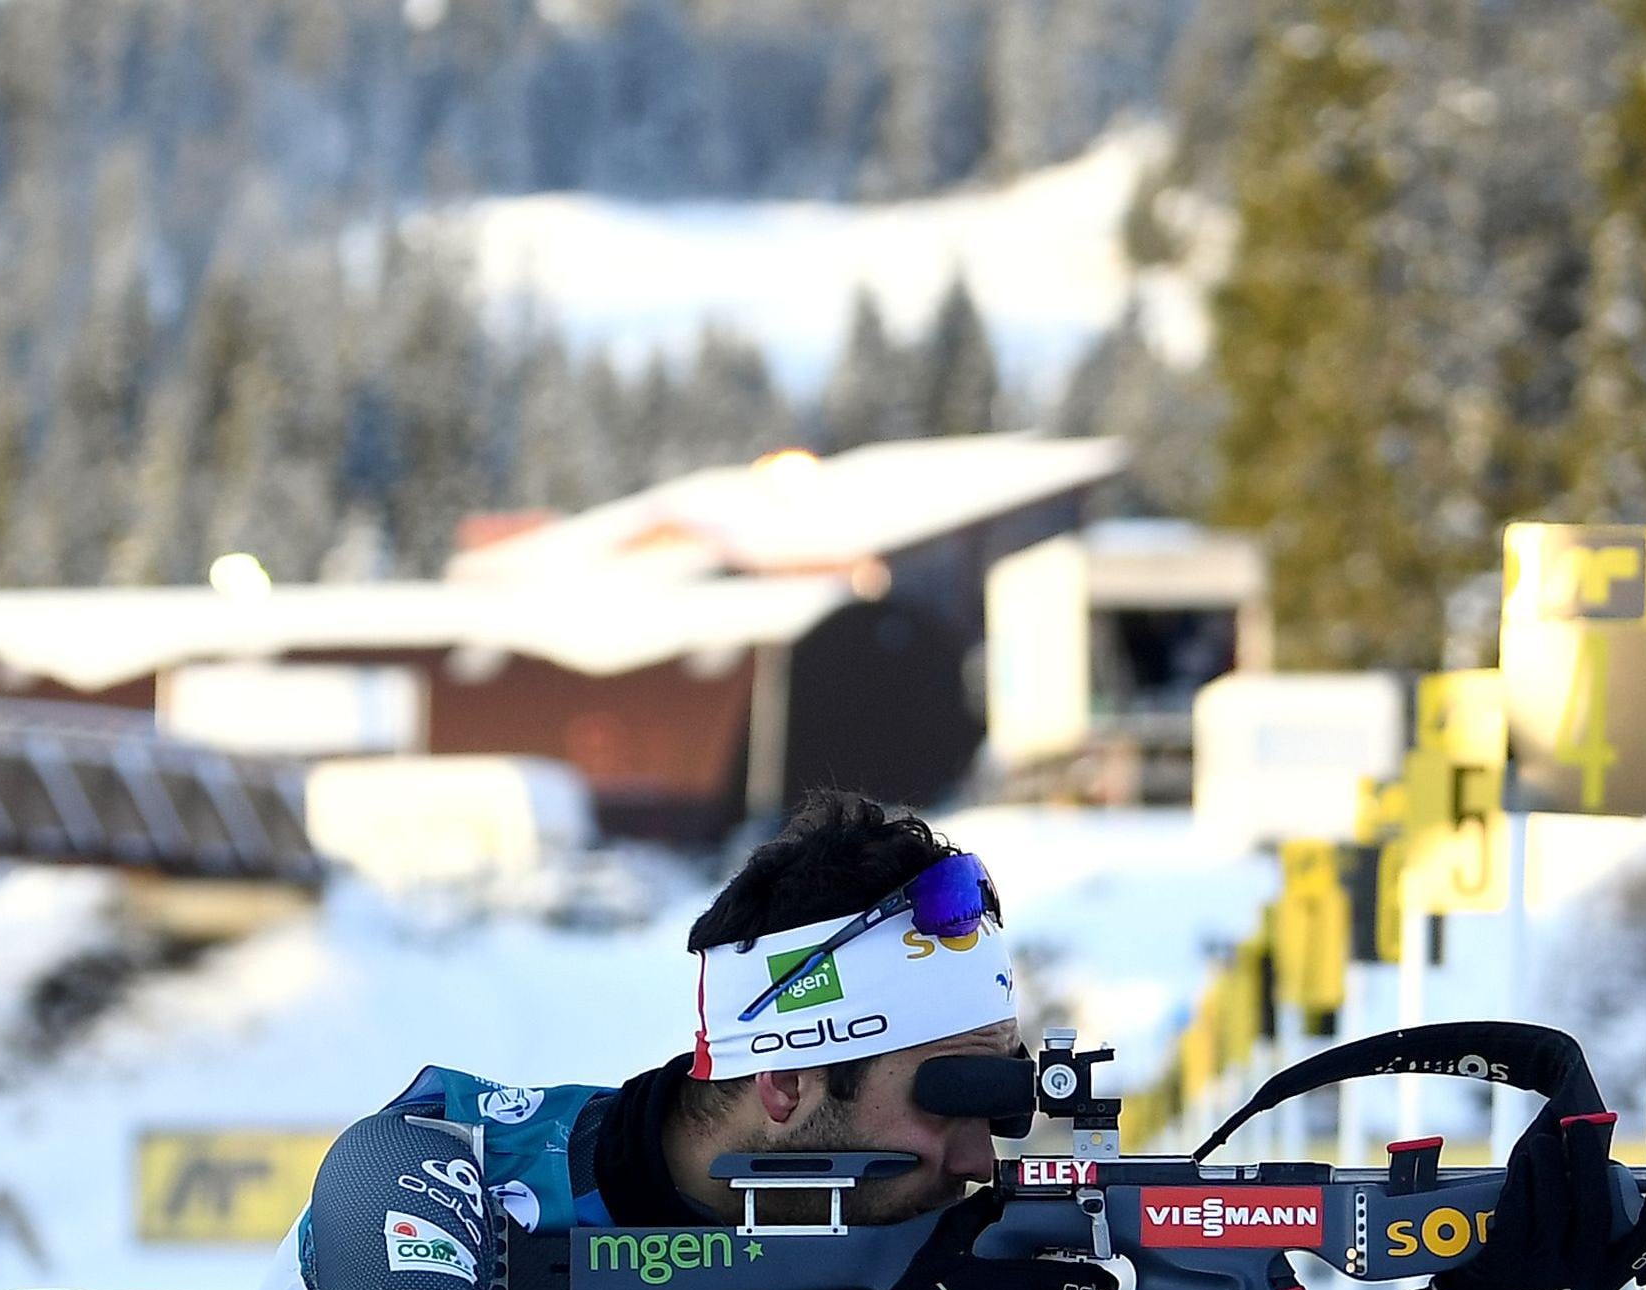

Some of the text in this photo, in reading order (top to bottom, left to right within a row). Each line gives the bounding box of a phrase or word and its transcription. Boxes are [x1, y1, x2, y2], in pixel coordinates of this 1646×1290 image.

[1556, 630, 1618, 808] 4
[1449, 764, 1491, 898] 5
[750, 1013, 889, 1054] odlo
[1023, 1160, 1092, 1186] ELEY
[1145, 1197, 1317, 1238] VIESSMANN
[589, 1232, 733, 1285] mgen
